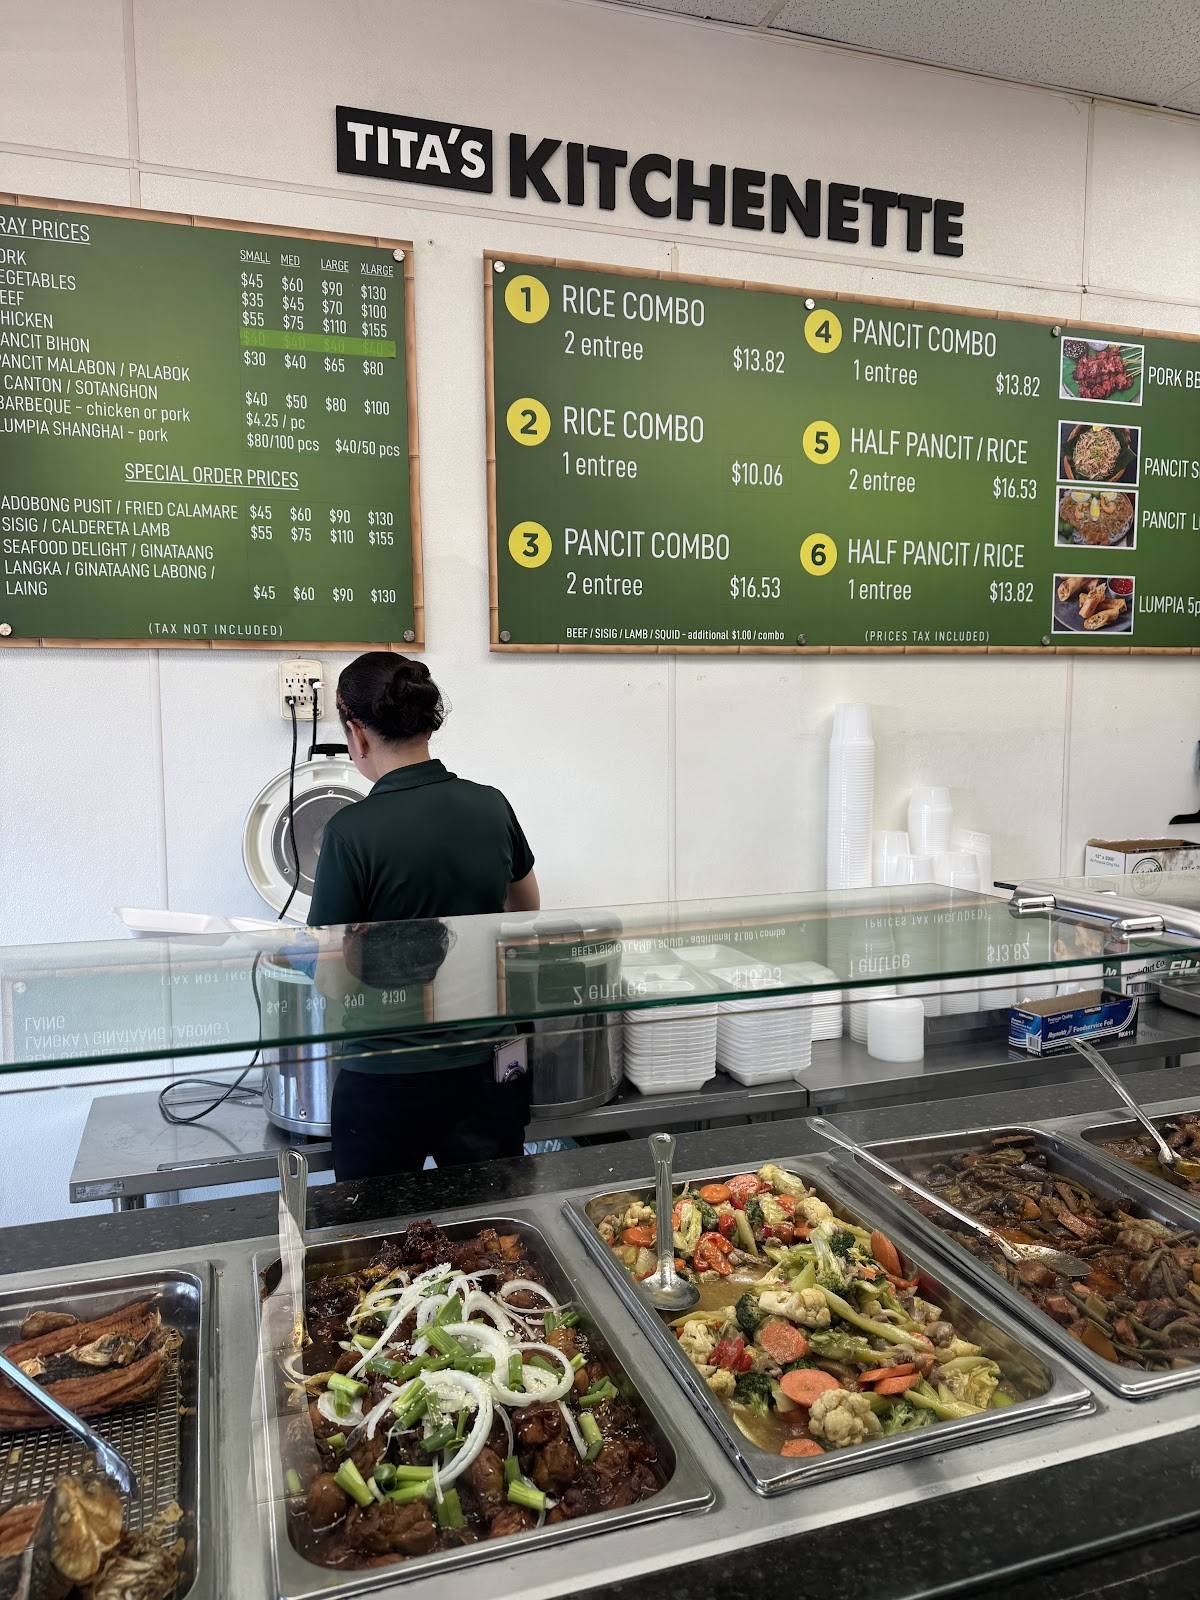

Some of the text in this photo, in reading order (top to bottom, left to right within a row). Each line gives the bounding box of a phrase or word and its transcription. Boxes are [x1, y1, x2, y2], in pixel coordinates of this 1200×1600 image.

[347, 121, 964, 257] TITA'S KITCHENETTE
[32, 219, 90, 242] PRICES
[240, 250, 393, 276] SMALL MED LARGE XLARGE
[241, 272, 386, 300] $45 $60 $90 $130
[242, 291, 386, 319] $35 $45 $70 $100
[520, 284, 704, 326] 1 RICE COMBO
[243, 310, 387, 338] $55 $75 $110 $155
[47, 335, 89, 353] BIHON
[815, 317, 996, 357] 4 PANCIT COMBO
[244, 350, 383, 375] $30 $40 $65 $80
[565, 330, 784, 373] 2 entree $13.82
[0, 353, 190, 382] ANCIT MALABON PALABOK
[854, 359, 1040, 397] 1 entree $13.82
[1149, 366, 1182, 387] PORK
[4, 375, 157, 400] CANTON SOTANGHON
[87, 402, 139, 418] chicken
[144, 408, 157, 419] or
[161, 408, 190, 423] pork
[246, 390, 389, 415] $40 $50 $80 $100
[53, 421, 123, 439] SHANGHAI
[139, 428, 168, 443] pork
[246, 411, 305, 431] $4.25 pc
[520, 406, 703, 443] 2 RICE COMBO
[247, 432, 400, 458] $80/100 pcs $40/50 pcs
[814, 428, 1028, 464] 5 HALF PANCIT RICE
[125, 463, 299, 488] SPECIAL ORDER PRICES
[563, 451, 783, 486] 1 entree $10.06
[1145, 458, 1189, 477] PANCIT
[849, 468, 1036, 499] 2 entree $16.53
[1, 495, 393, 526] ADOBONG PUSIT FRIED CALAMARE $45 $60 $90 $130
[1143, 511, 1200, 530] PANCIT L
[2, 517, 393, 546] SISIG CALDERETA LAMB $55 $75 $110 $155
[522, 528, 729, 560] 3 PANCIT COMBO
[3, 539, 213, 559] SEAFOOD DELIGHT GINATAANG
[811, 539, 1024, 568] 6 HALF PANCIT RICE
[5, 560, 206, 579] LANGKA GINATAANG LABONG
[6, 581, 395, 603] LAING $45 $60 $90 $130
[567, 572, 780, 599] 2 entree $16.53
[849, 579, 1033, 603] 1 entree $13.82
[1139, 596, 1184, 613] LUMPIA
[149, 623, 282, 636] (TAX NOT INCLUDED)
[567, 628, 784, 640] BEEF SISIG LAMB SQUID additional $1.00 combo
[865, 630, 989, 642] (PRICES TAX INCLUDED)
